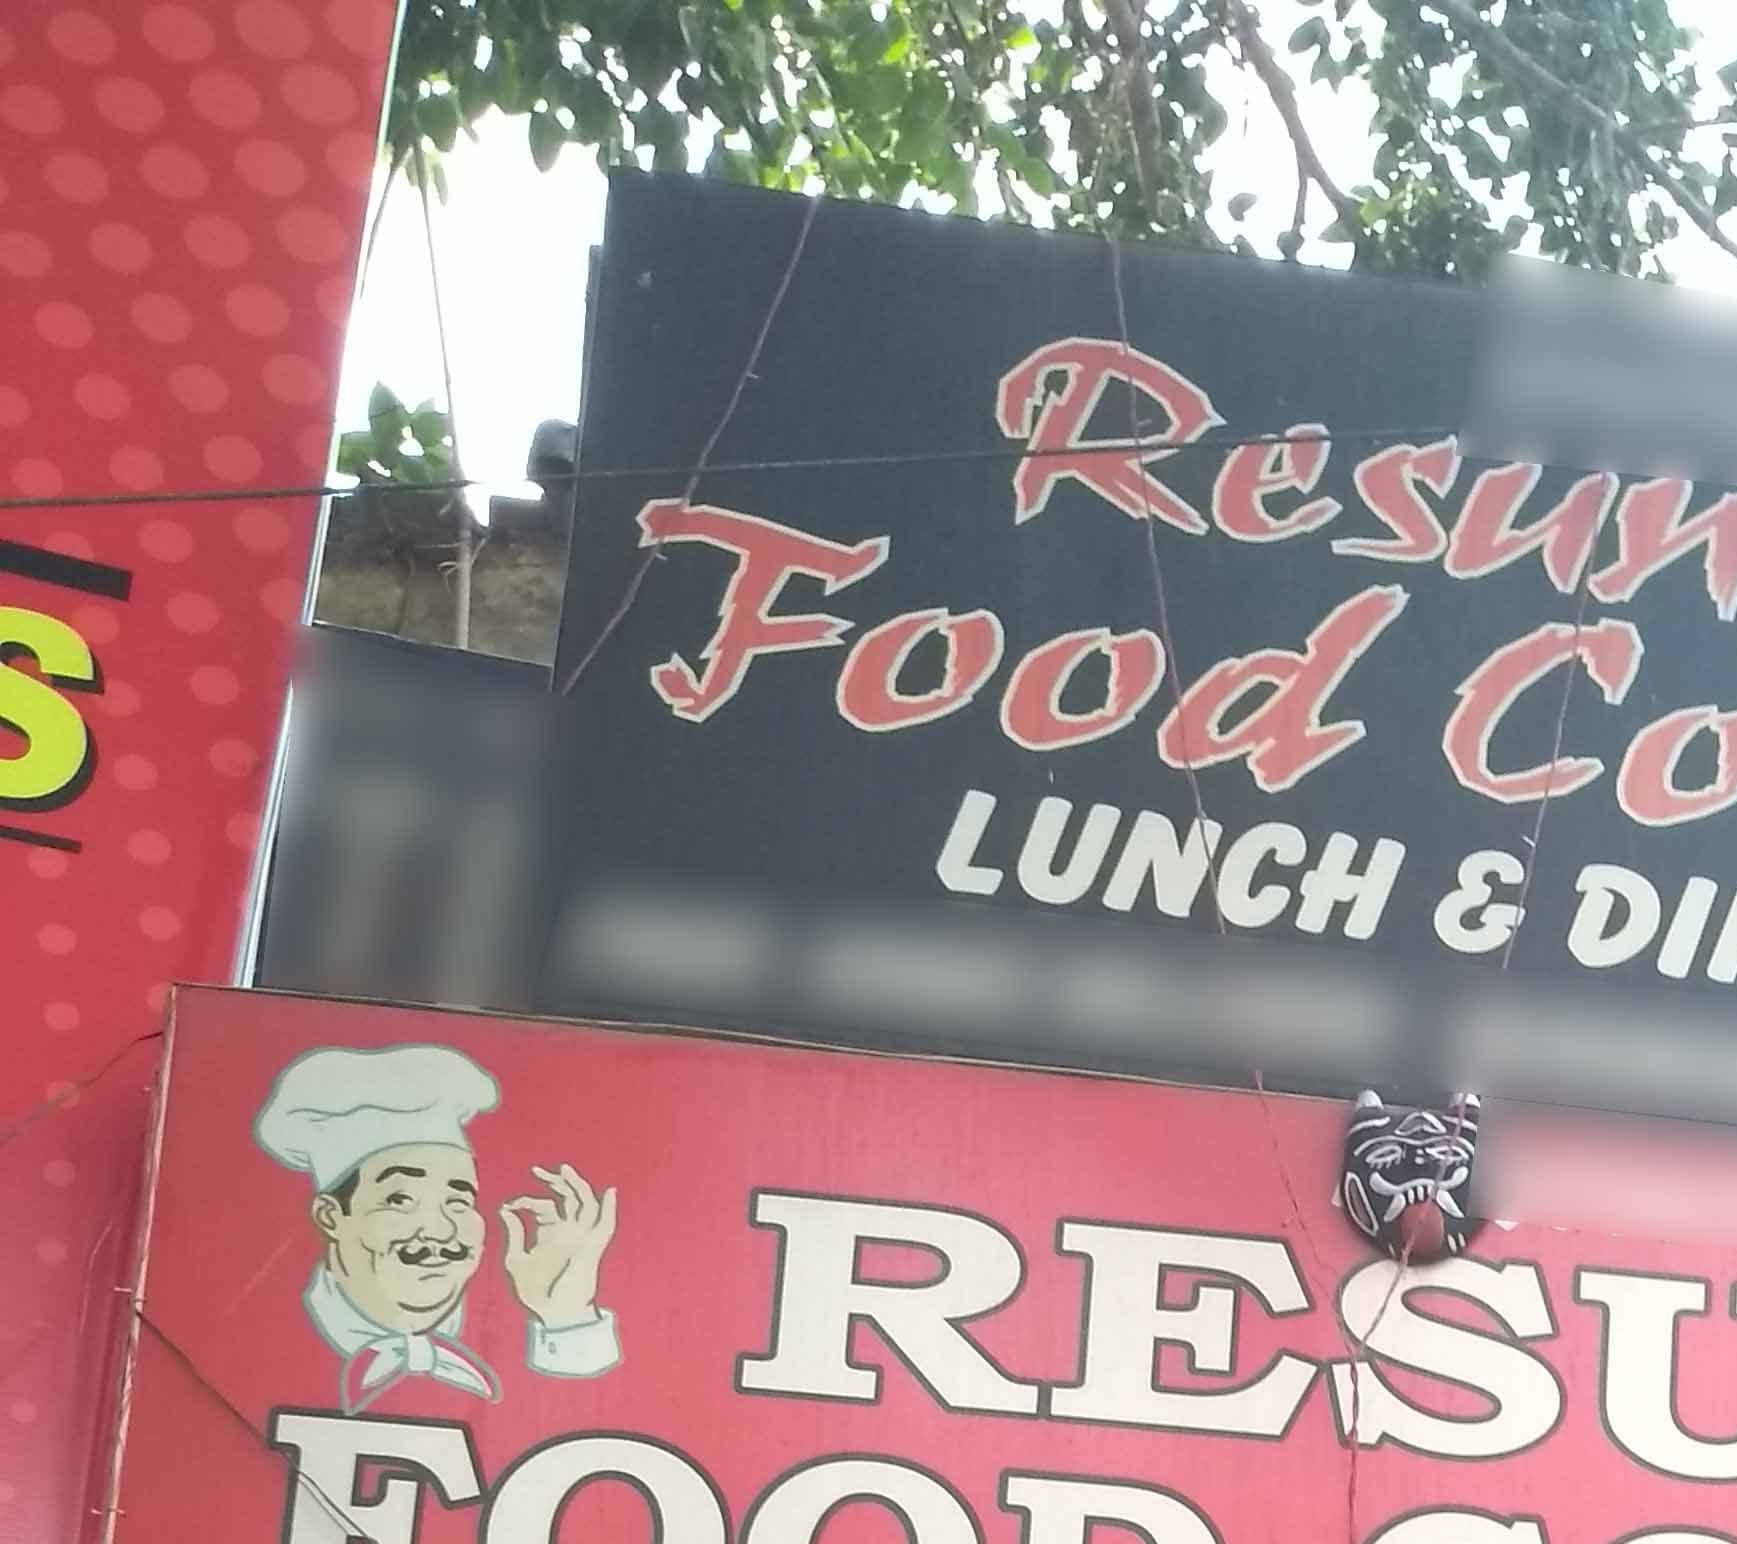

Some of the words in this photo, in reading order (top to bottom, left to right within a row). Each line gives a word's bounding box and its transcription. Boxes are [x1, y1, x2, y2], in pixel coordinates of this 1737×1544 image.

[636, 498, 1411, 793] Food
[936, 791, 1406, 940] LUNCH
[1434, 849, 1526, 953] &
